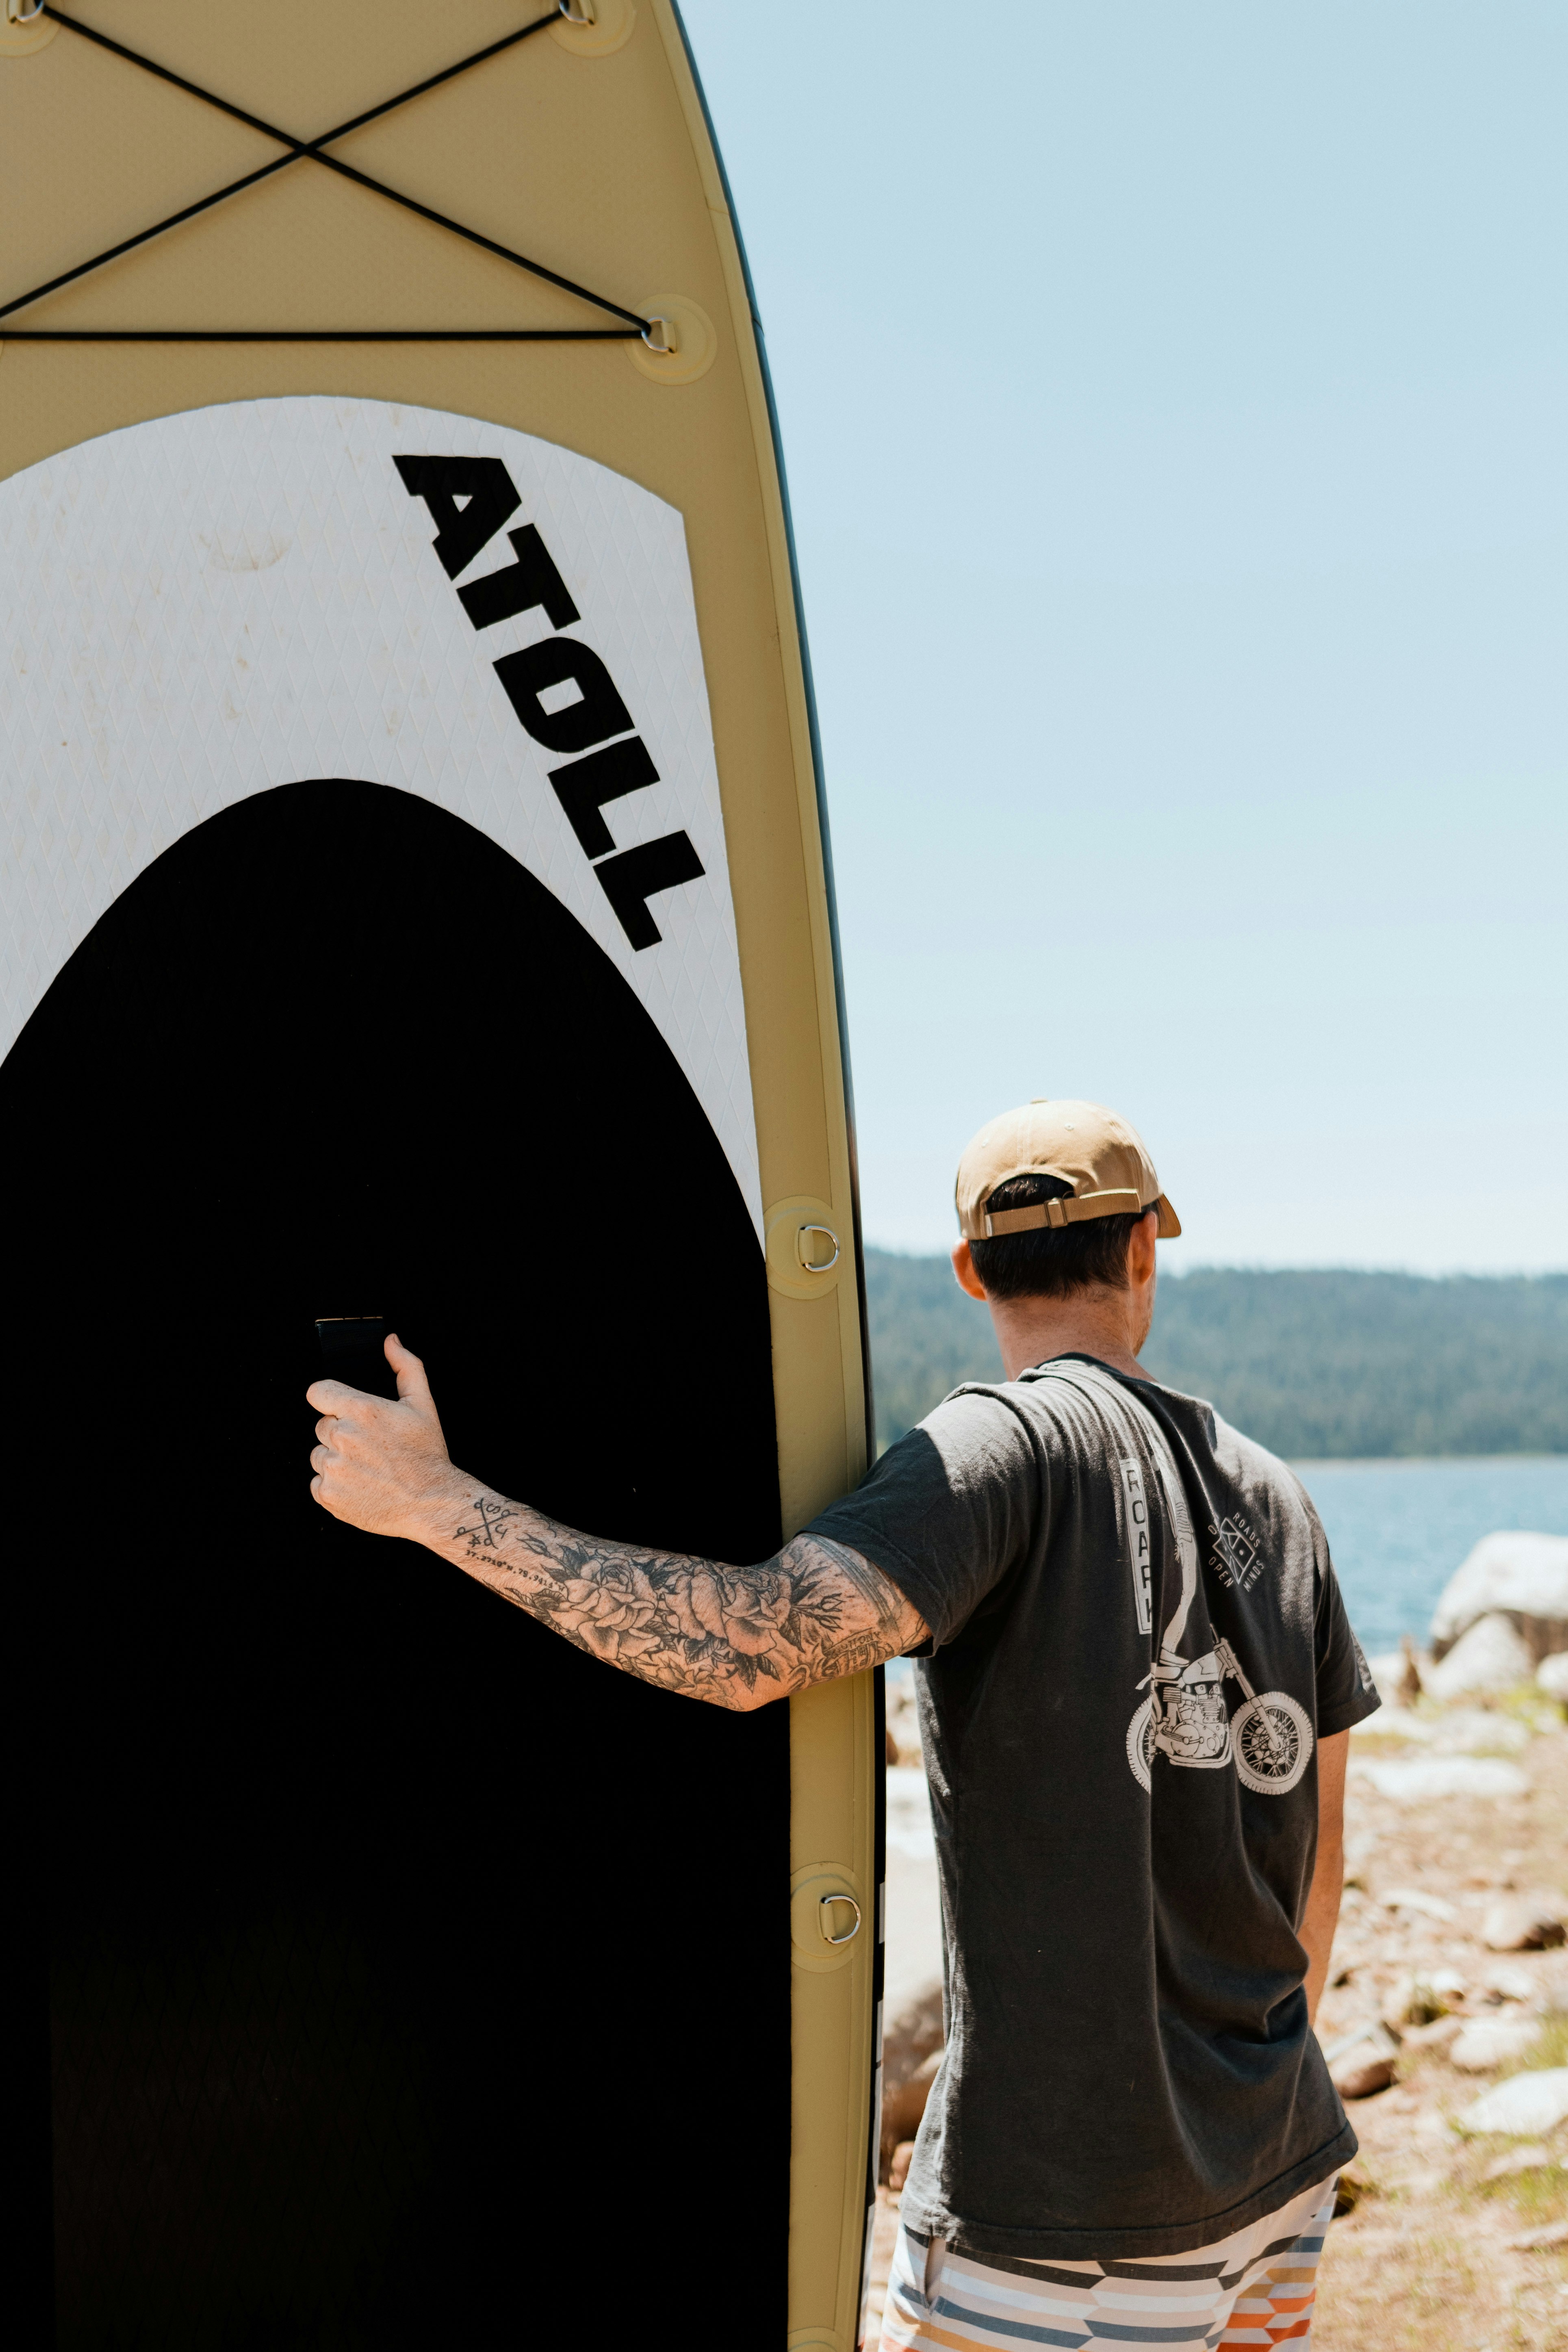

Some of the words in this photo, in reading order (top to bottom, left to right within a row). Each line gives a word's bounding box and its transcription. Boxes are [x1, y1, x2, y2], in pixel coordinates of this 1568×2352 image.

[392, 455, 706, 952] ATOLL
[1232, 1512, 1260, 1548] ROADS
[1208, 1556, 1234, 1588] OPEN
[1243, 1560, 1264, 1593] MINDS
